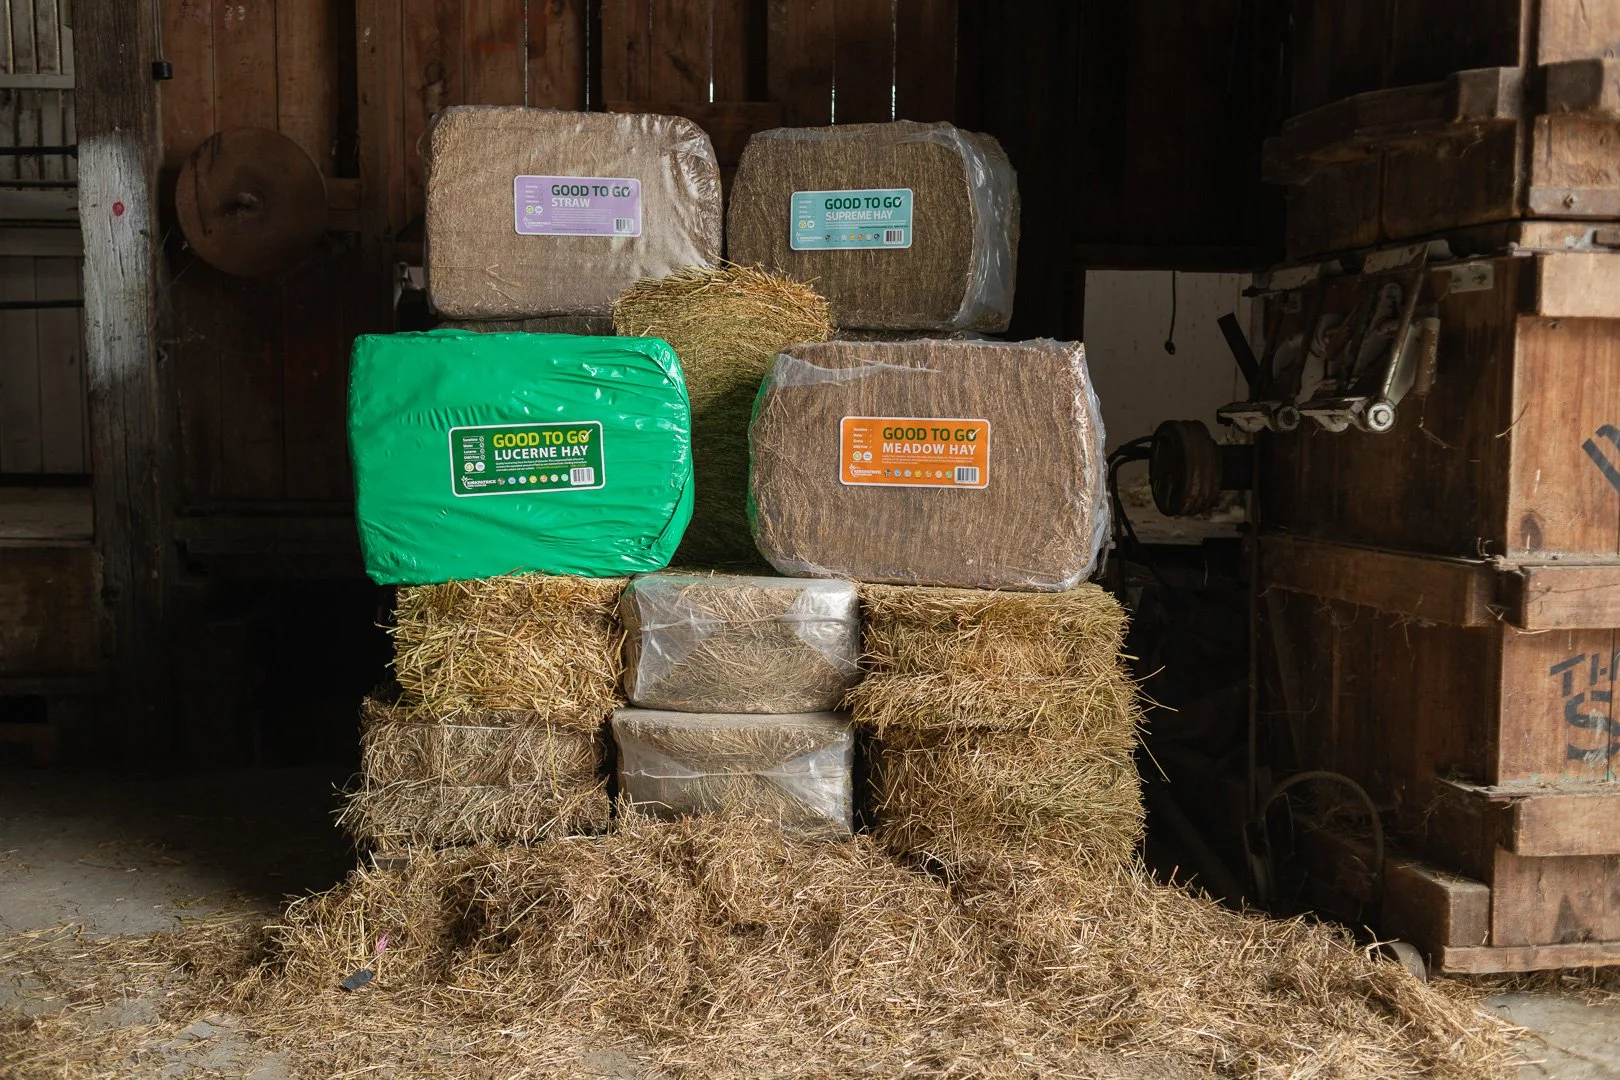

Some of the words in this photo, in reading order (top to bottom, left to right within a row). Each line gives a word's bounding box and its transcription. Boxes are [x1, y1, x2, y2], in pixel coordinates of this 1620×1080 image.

[551, 184, 589, 197] GOOD
[592, 185, 609, 197] TO
[612, 186, 631, 198] GO
[551, 198, 590, 208] STRAW
[824, 197, 861, 210] GOOD
[864, 197, 880, 209] TO
[883, 196, 902, 209] GO
[825, 210, 872, 221] SUPREME
[874, 209, 893, 219] HAY
[492, 432, 539, 448] GOOD
[542, 431, 563, 445] TO
[566, 430, 590, 444] GO
[882, 427, 927, 441] GOOD
[930, 427, 950, 442] TO
[954, 428, 977, 442] GO
[494, 447, 557, 461] LUCERNE
[561, 445, 589, 457] HAY
[882, 442, 945, 455] MEADOW
[949, 444, 977, 455] HAY
